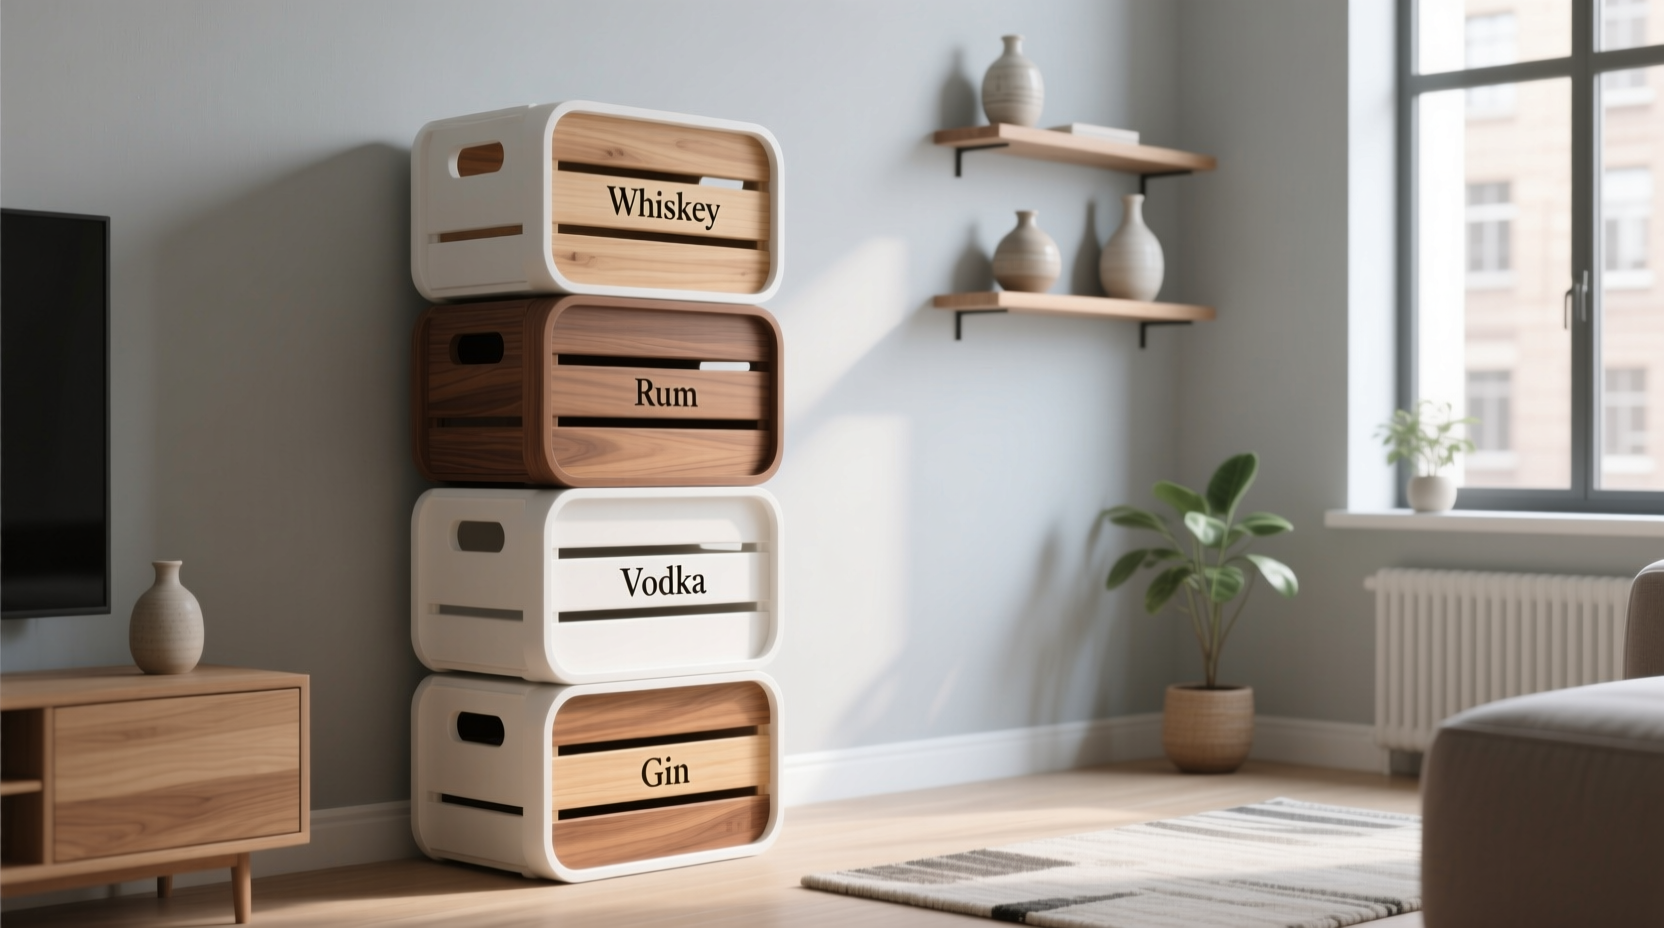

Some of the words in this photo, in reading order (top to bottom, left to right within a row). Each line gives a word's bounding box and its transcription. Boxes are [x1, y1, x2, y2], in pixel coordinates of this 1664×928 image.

[607, 186, 720, 231] Whiskey
[634, 378, 698, 407] Rum
[620, 565, 707, 597] Vodka
[641, 757, 690, 787] Gin
